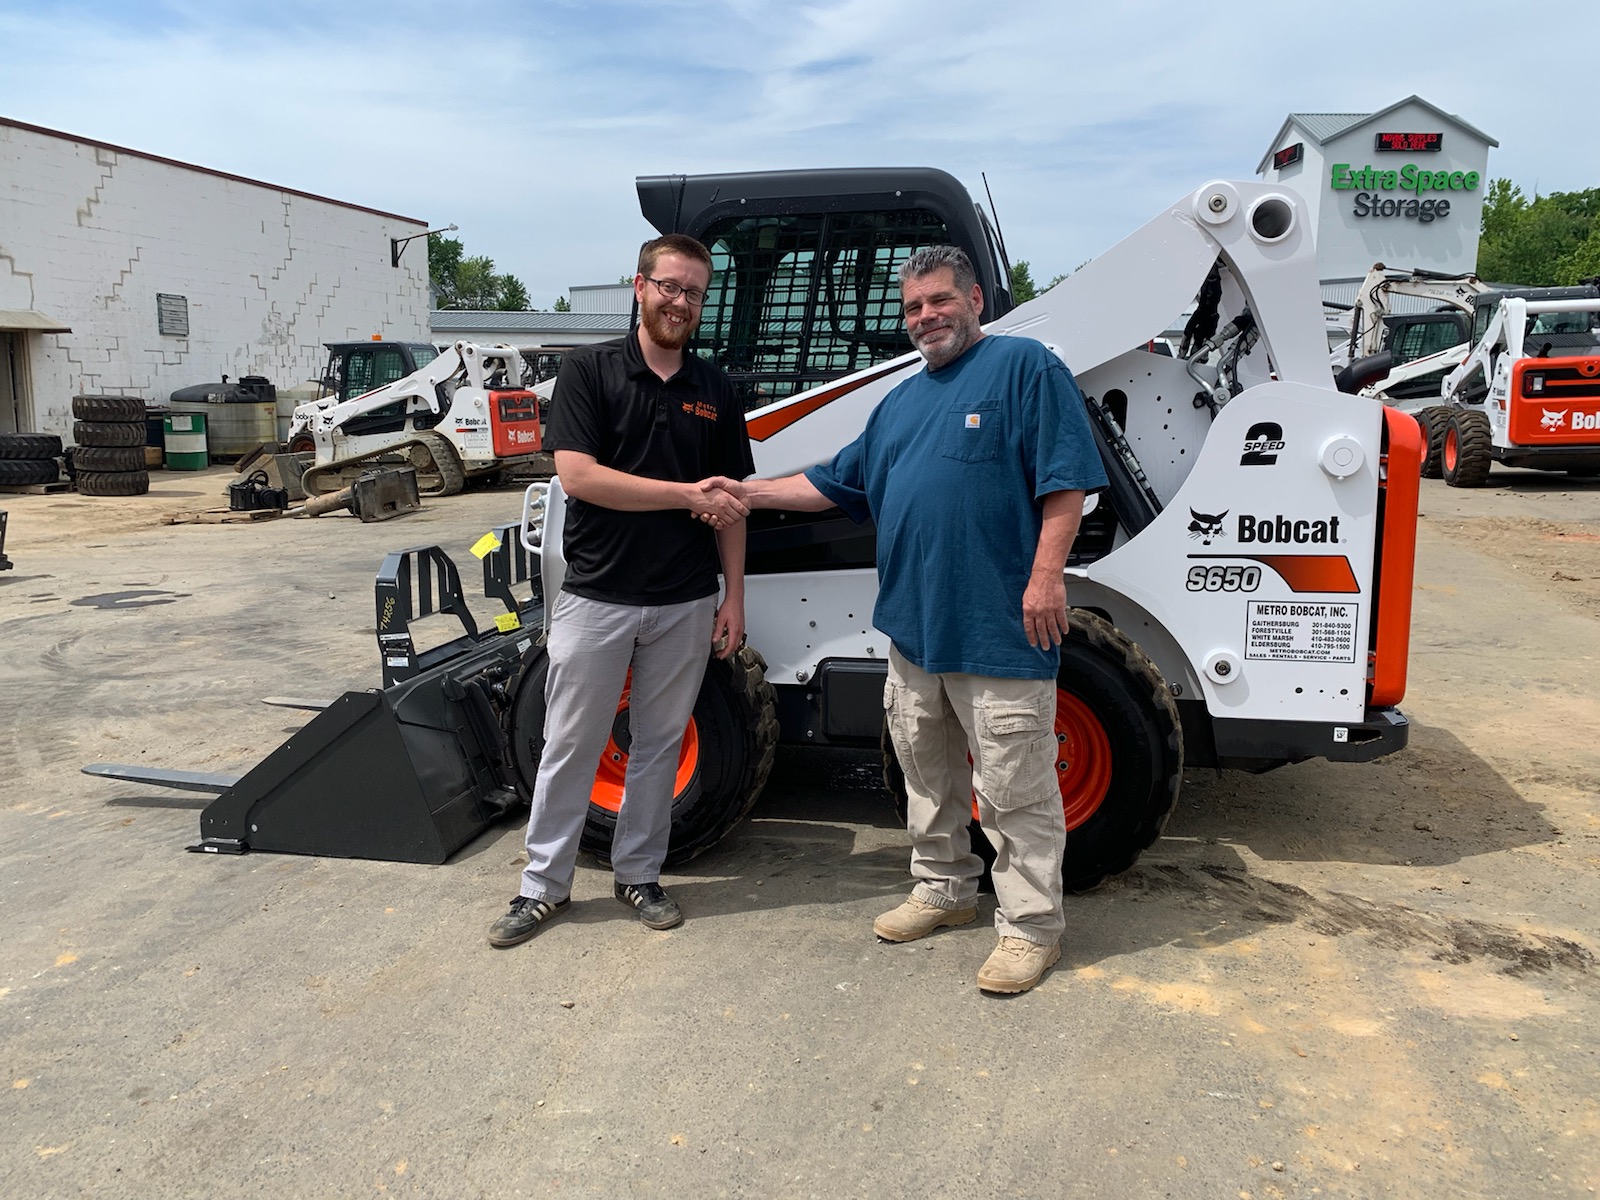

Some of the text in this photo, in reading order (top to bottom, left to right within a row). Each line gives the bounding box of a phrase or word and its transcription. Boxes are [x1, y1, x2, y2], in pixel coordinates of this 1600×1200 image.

[1408, 134, 1437, 142] SUPPLIES
[1353, 193, 1450, 222] Storage
[695, 406, 717, 421] Bobcat
[1240, 422, 1283, 466] 2
[1243, 441, 1285, 451] SPEED
[1238, 515, 1340, 543] Bobcat
[1186, 566, 1262, 592] S650
[1257, 605, 1348, 618] METRO BOBCAT, INC.
